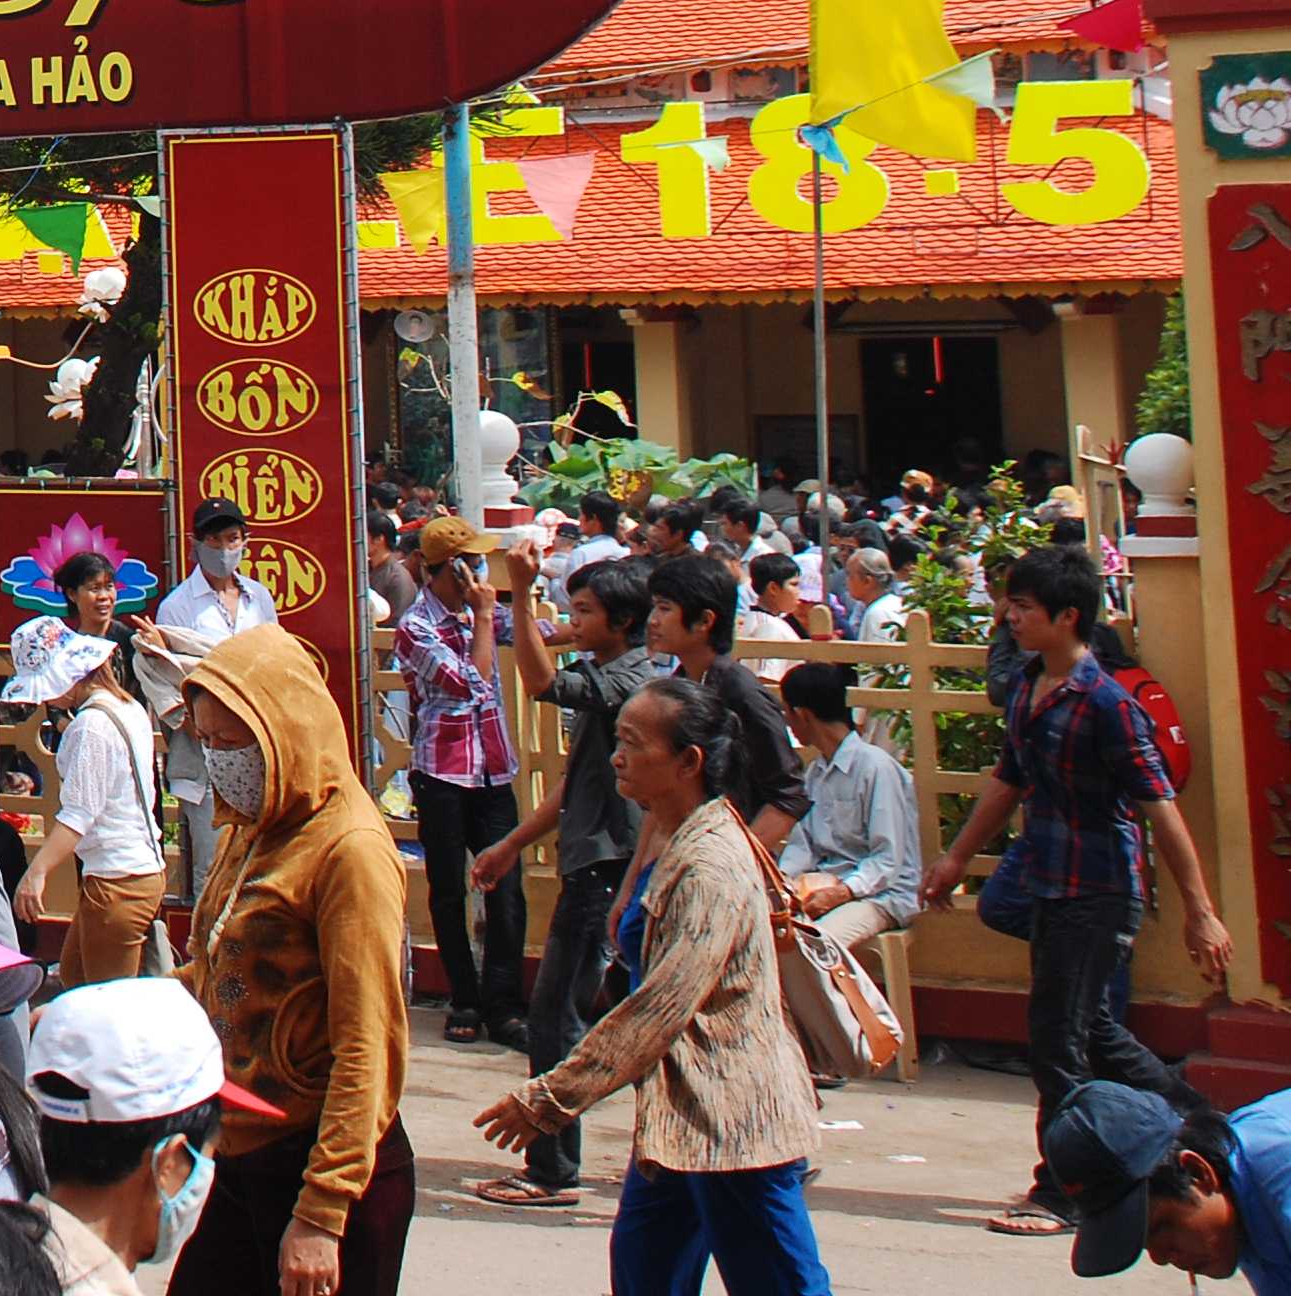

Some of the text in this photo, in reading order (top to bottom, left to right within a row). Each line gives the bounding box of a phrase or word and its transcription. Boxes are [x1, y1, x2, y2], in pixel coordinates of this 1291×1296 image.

[32, 36, 132, 104] HẢO
[202, 274, 309, 342] KHẮP
[204, 363, 310, 430] BỐN
